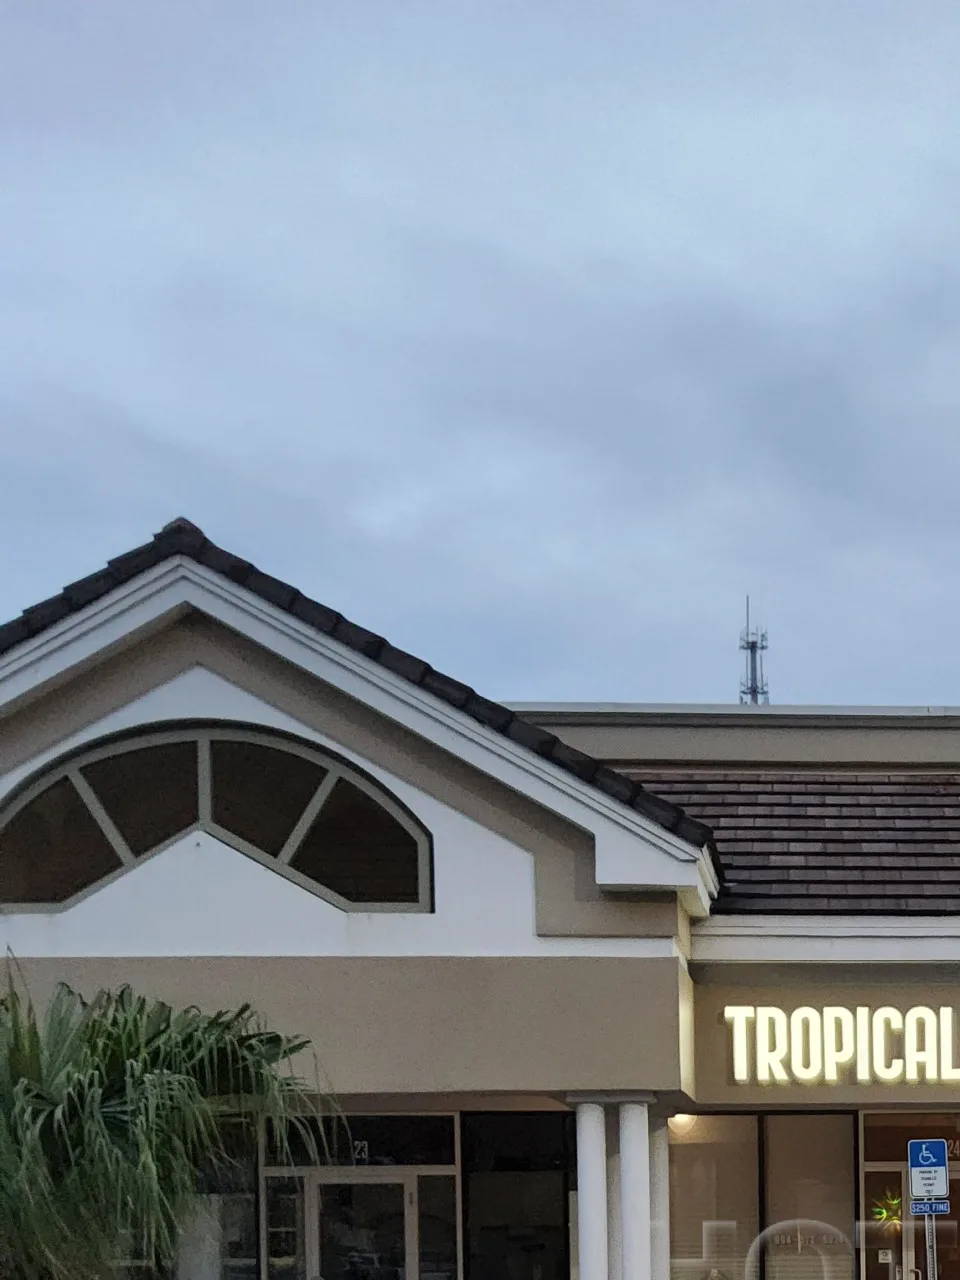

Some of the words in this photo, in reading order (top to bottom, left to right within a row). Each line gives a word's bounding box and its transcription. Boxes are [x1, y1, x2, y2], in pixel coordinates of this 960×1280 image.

[354, 1140, 368, 1159] 23
[948, 1139, 960, 1157] 24
[911, 1203, 930, 1213] $250
[932, 1202, 948, 1212] FINE
